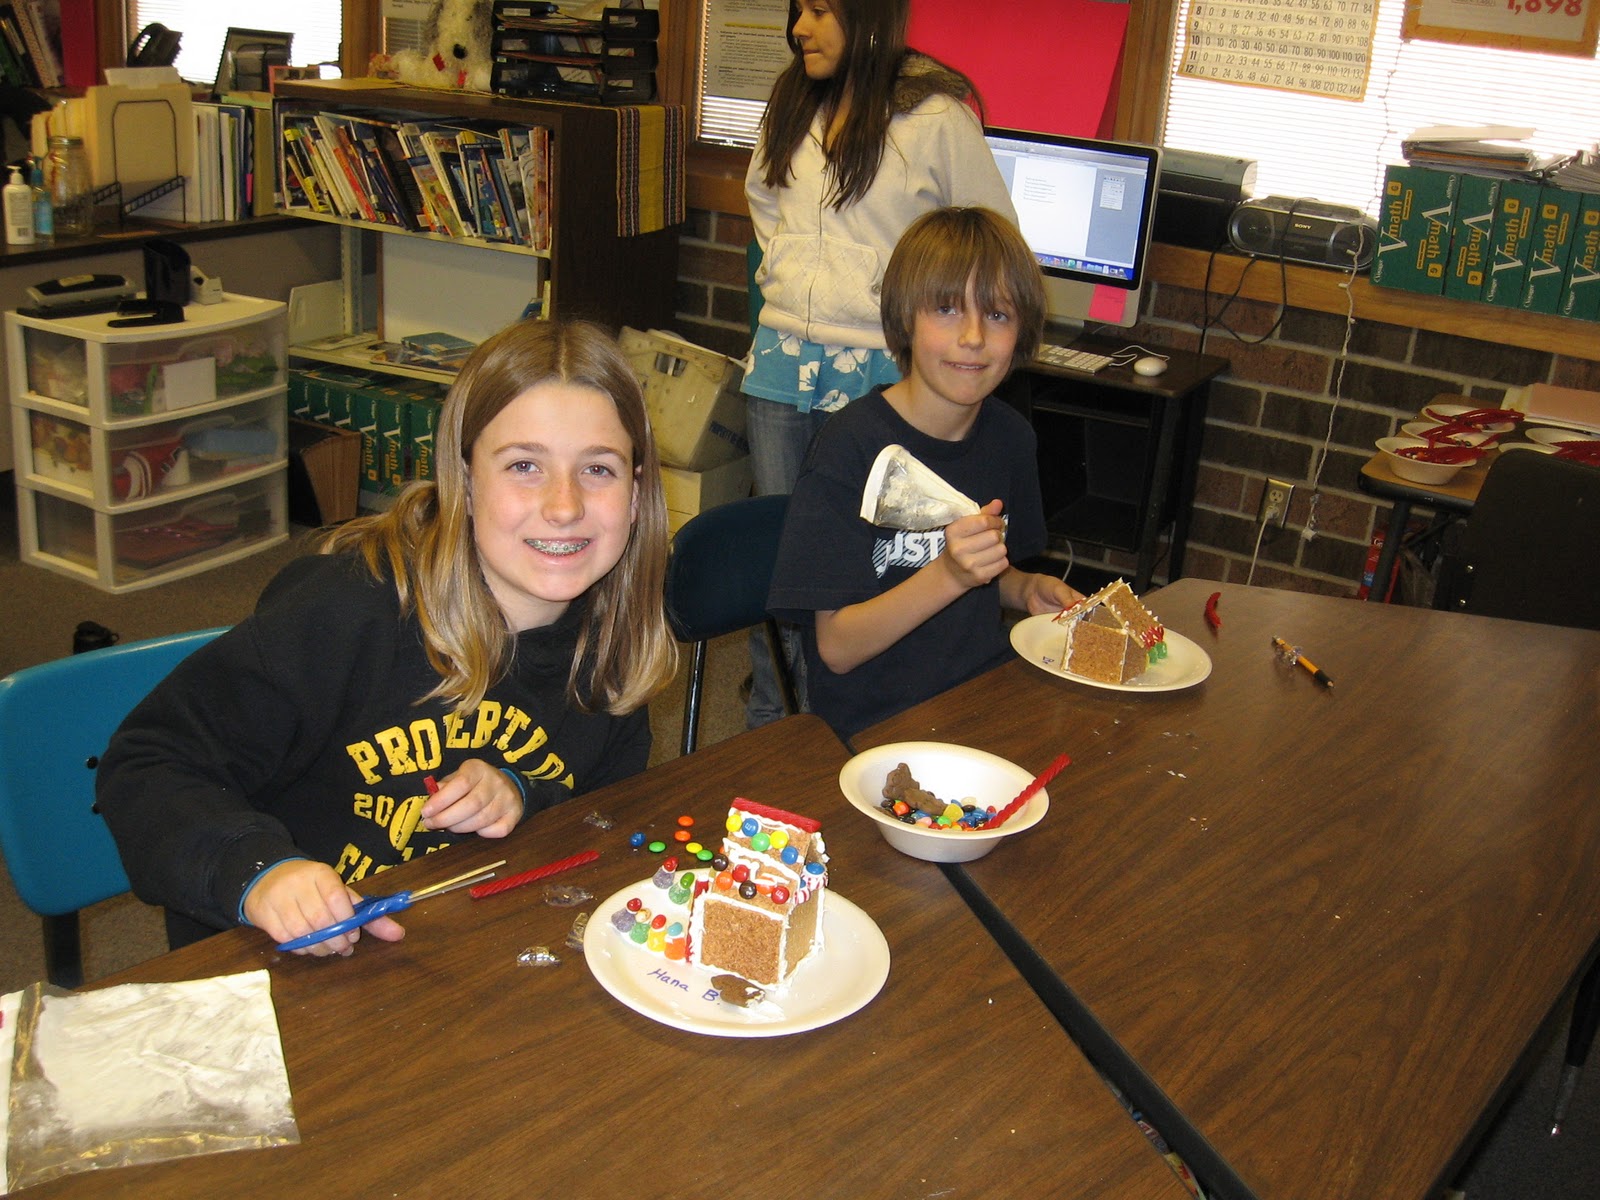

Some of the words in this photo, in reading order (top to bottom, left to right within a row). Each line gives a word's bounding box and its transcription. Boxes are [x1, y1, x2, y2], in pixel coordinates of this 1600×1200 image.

[1196, 6, 1201, 15] 8
[1209, 7, 1214, 16] 0
[1221, 8, 1226, 17] 8
[1232, 9, 1239, 18] 16
[1244, 10, 1253, 20] 24
[1257, 11, 1266, 21] 32
[1270, 12, 1279, 22] 40
[1283, 14, 1291, 23] 48
[1296, 15, 1304, 24] 56
[1308, 16, 1317, 26] 64
[1322, 17, 1330, 27] 72
[1334, 18, 1343, 28] 80
[1347, 19, 1356, 29] 88
[1361, 20, 1369, 31] 96
[1323, 0, 1332, 10] 63
[1337, 1, 1345, 11] 70
[1351, 2, 1359, 12] 77
[1363, 3, 1372, 14] 84
[1194, 21, 1199, 30] 9
[1206, 21, 1211, 32] 0
[1219, 23, 1224, 32] 9
[1242, 25, 1250, 35] 27
[1254, 27, 1263, 36] 36
[1268, 29, 1276, 38] 45
[1280, 29, 1289, 38] 54
[1293, 30, 1301, 40] 63
[1306, 31, 1314, 41] 72
[1319, 33, 1327, 42] 81
[1332, 34, 1341, 44] 90
[1192, 35, 1200, 45] 10
[1205, 36, 1210, 46] 0
[1217, 38, 1224, 47] 10
[1228, 39, 1237, 48] 20
[1241, 40, 1249, 50] 30
[1253, 42, 1262, 51] 40
[1266, 43, 1275, 52] 50
[1279, 45, 1287, 54] 60
[1291, 45, 1300, 55] 70
[1304, 47, 1313, 57] 80
[1317, 48, 1326, 58] 90
[1328, 50, 1340, 59] 100
[1342, 51, 1352, 61] 110
[1354, 53, 1365, 62] 120
[1190, 50, 1197, 60] 11
[1203, 52, 1208, 61] 0
[1215, 53, 1221, 62] 11
[1226, 54, 1234, 64] 22
[1239, 56, 1247, 65] 33
[1251, 58, 1259, 67] 44
[1263, 59, 1272, 68] 55
[1276, 60, 1285, 70] 66
[1289, 61, 1298, 71] 77
[1302, 63, 1311, 73] 88
[1315, 64, 1324, 74] 99
[1327, 66, 1337, 76] 110
[1340, 67, 1350, 77] 121
[1353, 69, 1364, 79] 132
[1185, 64, 1194, 73] 12
[1199, 66, 1204, 74] 0
[1211, 67, 1217, 76] 12
[1222, 68, 1230, 78] 24
[1234, 70, 1243, 79] 36
[1247, 72, 1256, 81] 48
[1260, 73, 1269, 83] 60
[1273, 74, 1281, 84] 72
[1285, 76, 1294, 85] 84
[1299, 78, 1306, 88] 96
[1311, 80, 1321, 89] 108
[1323, 82, 1334, 91] 120
[1336, 83, 1347, 93] 132
[1350, 85, 1360, 95] 144
[647, 968, 689, 992] Hana
